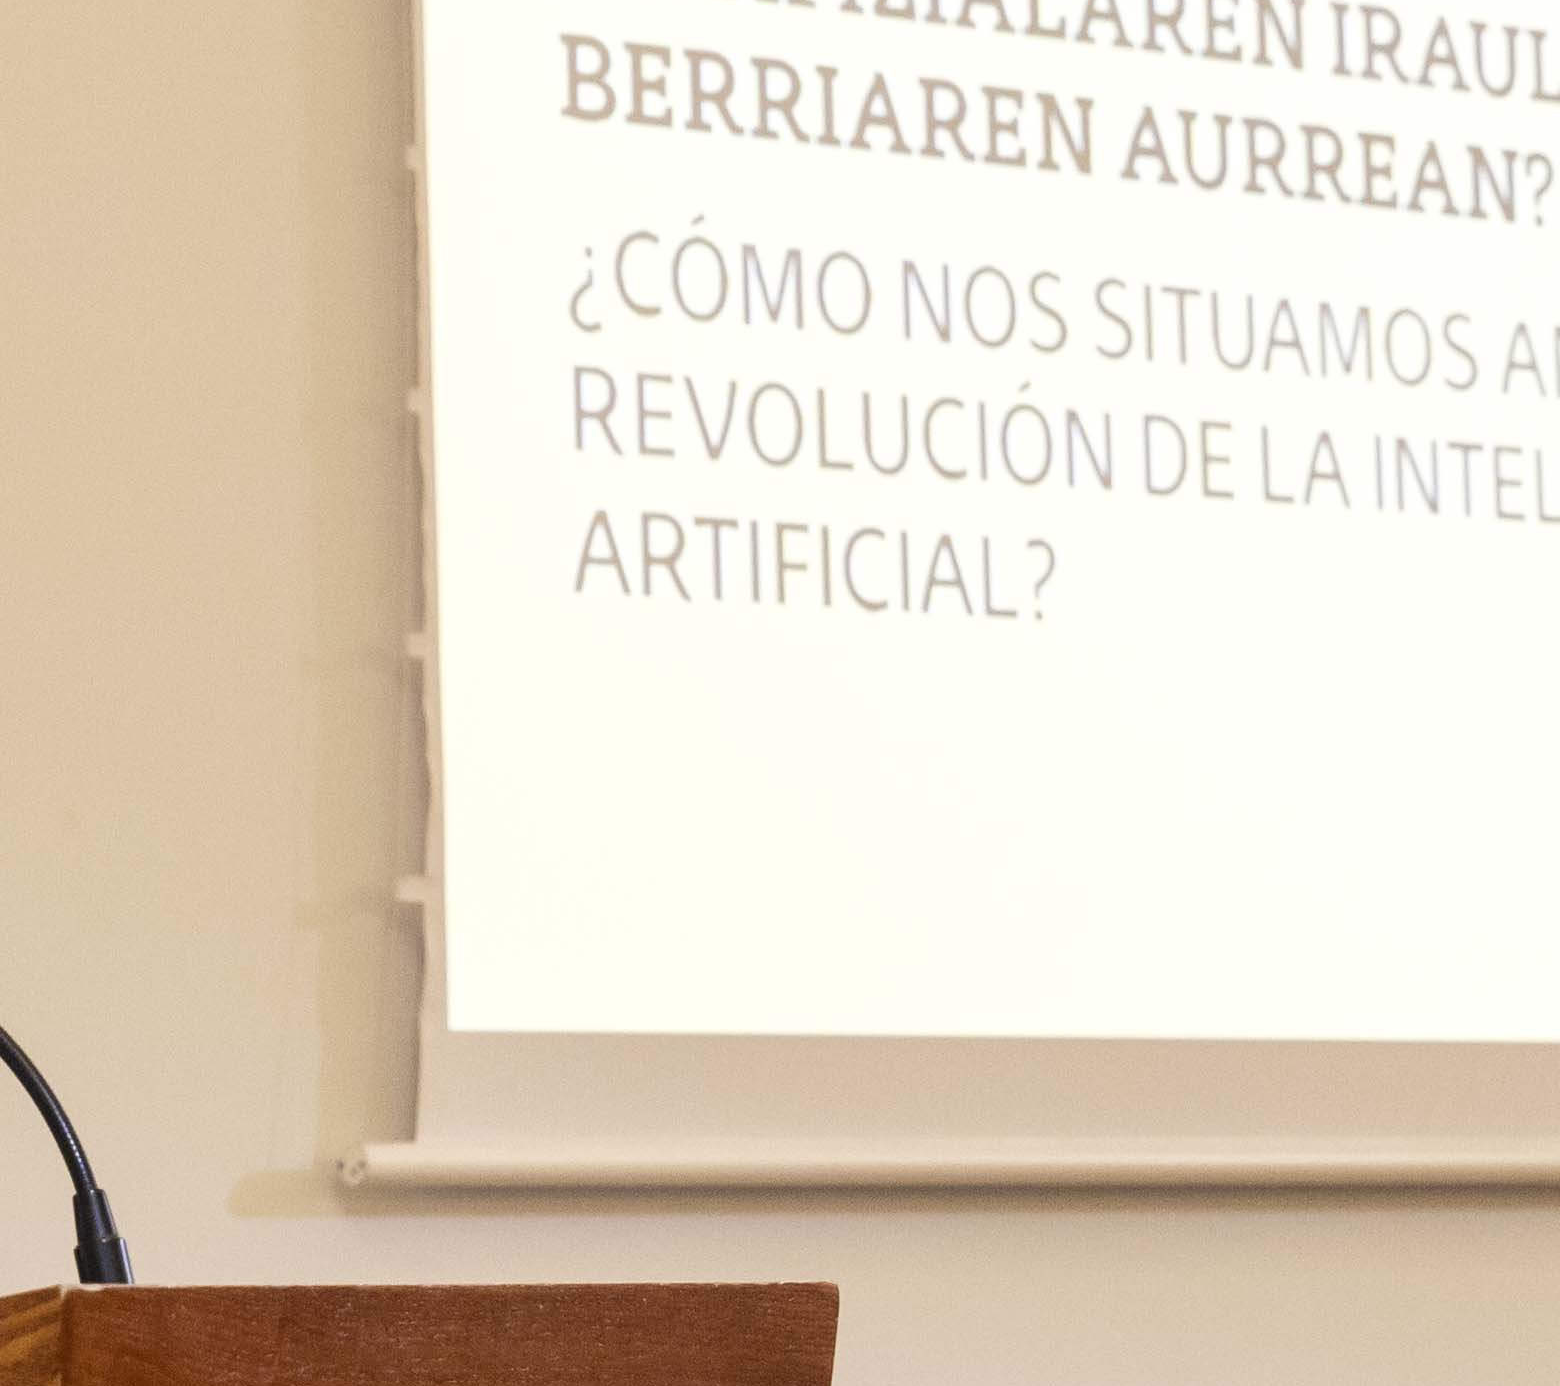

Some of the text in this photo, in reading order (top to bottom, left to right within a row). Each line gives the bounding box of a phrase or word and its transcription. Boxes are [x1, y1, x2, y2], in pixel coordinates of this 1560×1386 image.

[557, 30, 1556, 230] BERRIAREN AURREAN?
[566, 215, 876, 340] ¿CÓMO
[899, 258, 1071, 357] NOS
[1092, 275, 1481, 395] SITUAMOS
[570, 362, 1115, 496] REVOLUCIÓN
[1141, 412, 1237, 502] DE
[1259, 424, 1352, 511] LA
[572, 507, 1057, 626] ARTIFICIAL?
